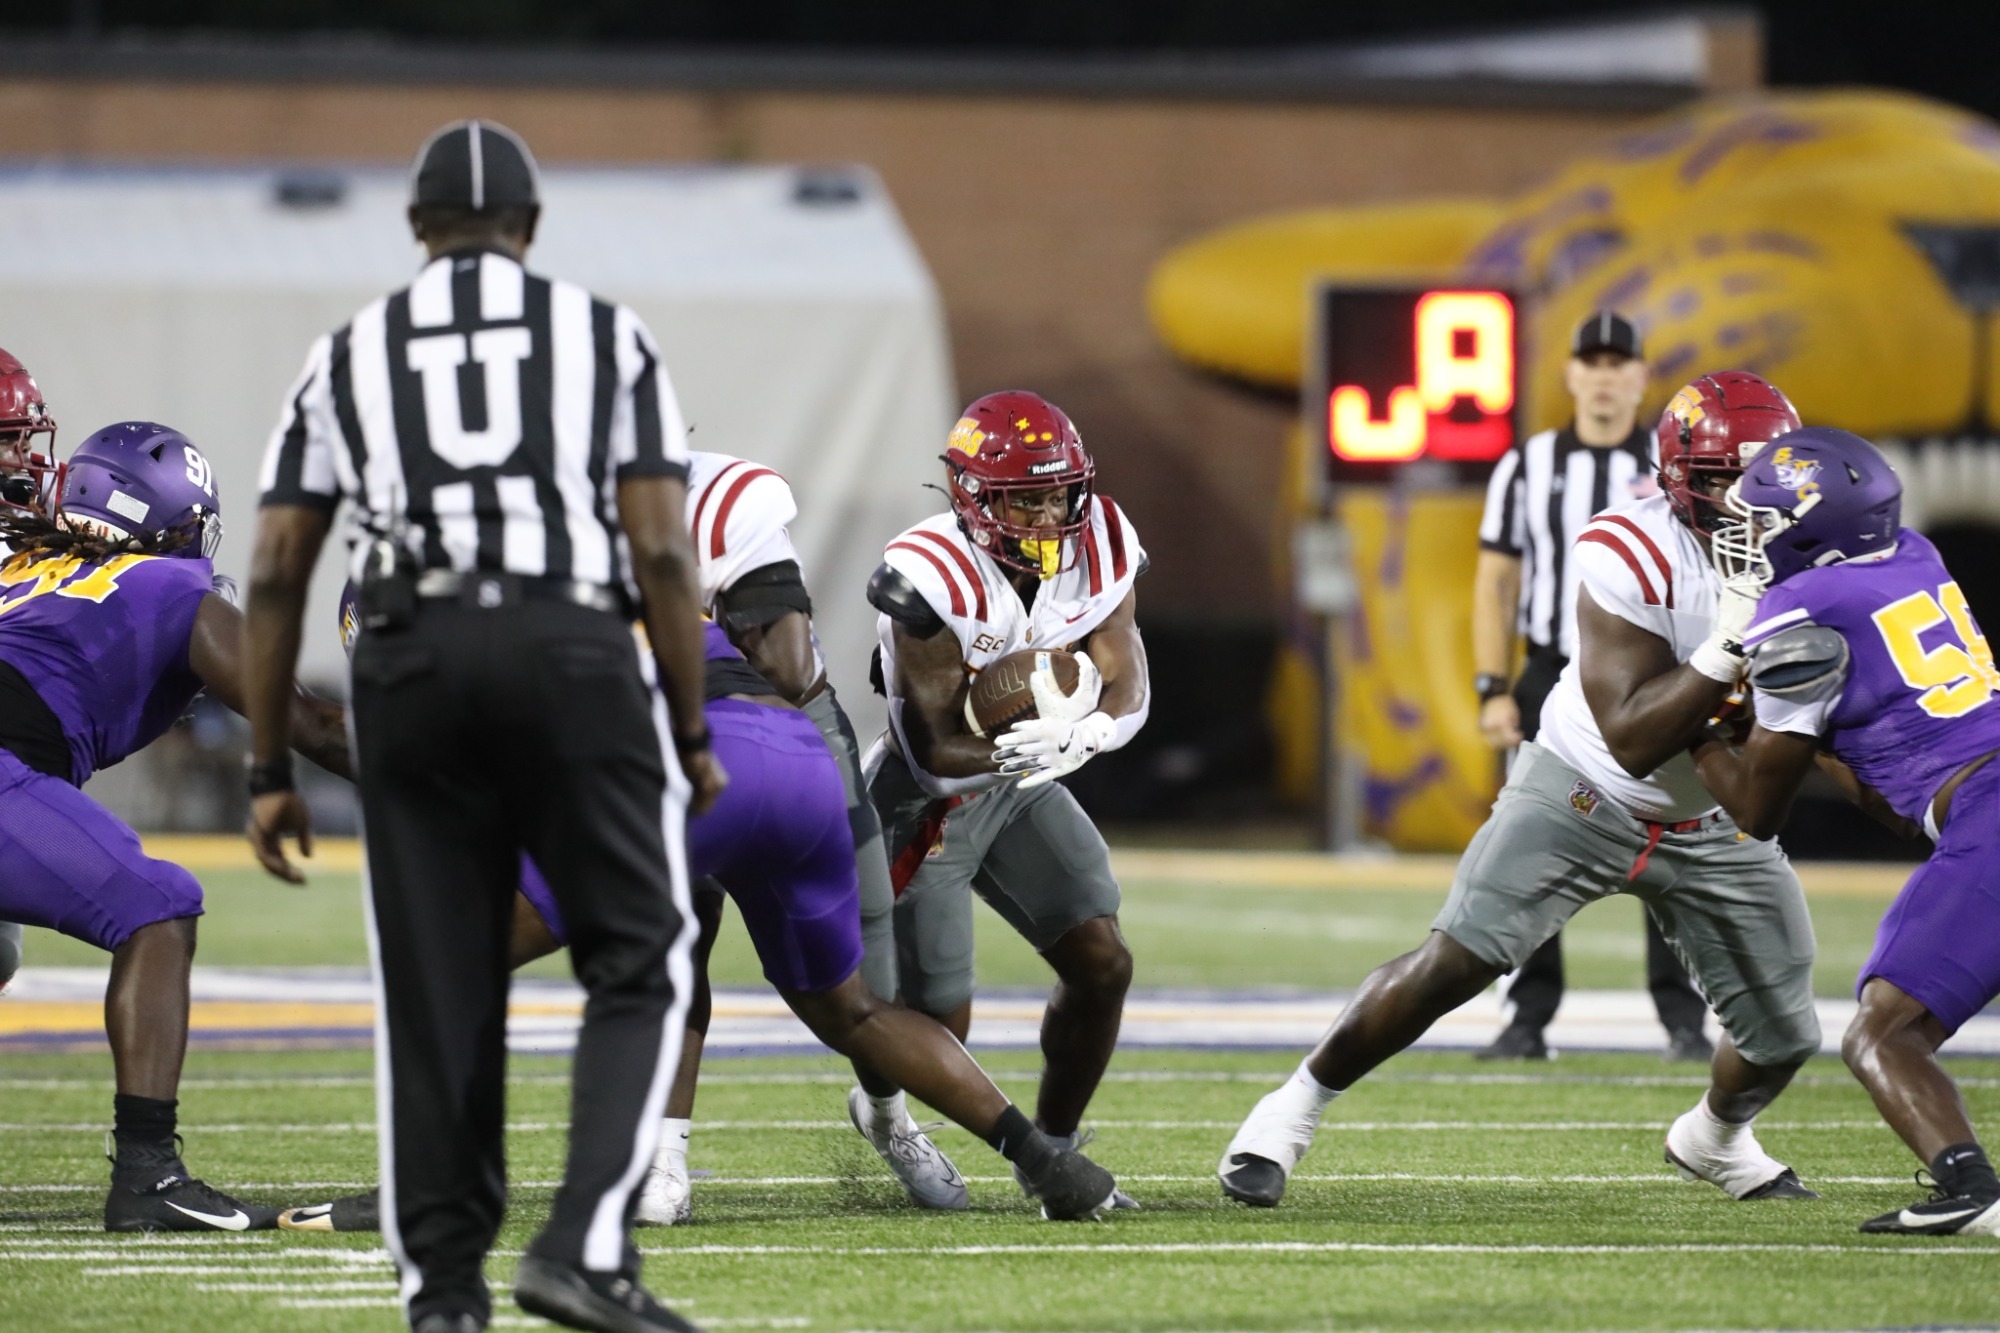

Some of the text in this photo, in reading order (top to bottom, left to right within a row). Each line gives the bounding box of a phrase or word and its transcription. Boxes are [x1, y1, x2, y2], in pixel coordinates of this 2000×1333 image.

[406, 326, 532, 470] U
[183, 446, 213, 498] 91
[1032, 459, 1068, 475] Riddell
